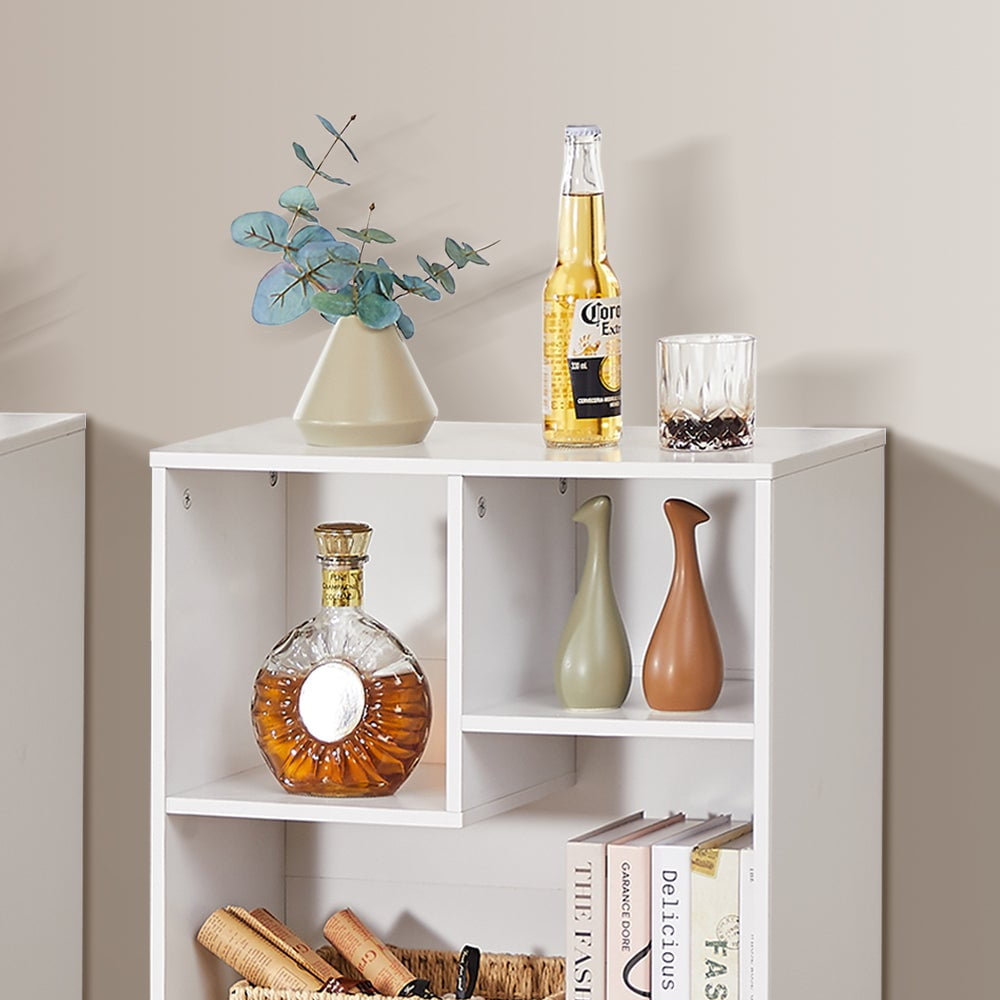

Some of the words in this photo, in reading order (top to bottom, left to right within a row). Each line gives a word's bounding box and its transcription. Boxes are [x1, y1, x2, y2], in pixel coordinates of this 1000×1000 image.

[574, 861, 593, 922] THE
[621, 862, 631, 919] GARANCE
[661, 870, 678, 991] Delicious
